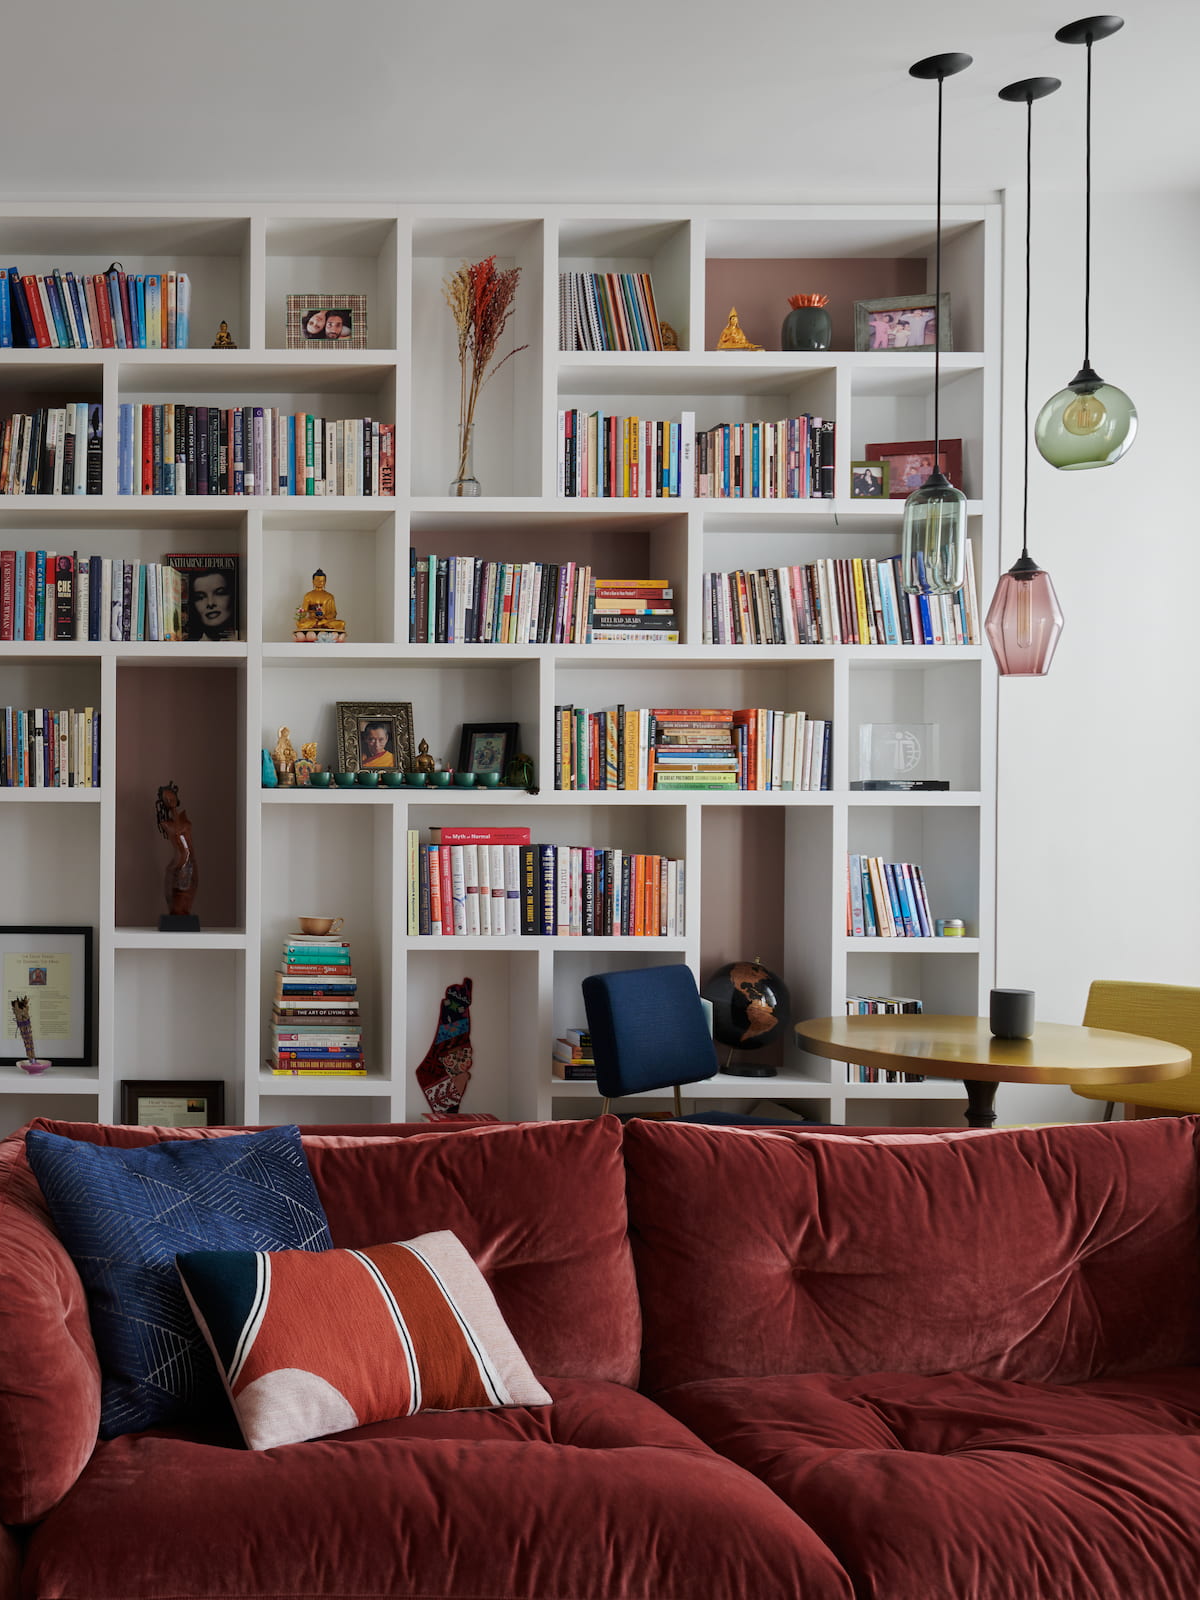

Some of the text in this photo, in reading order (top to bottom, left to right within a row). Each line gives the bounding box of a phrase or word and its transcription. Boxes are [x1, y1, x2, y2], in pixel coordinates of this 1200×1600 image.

[220, 446, 228, 474] Invasion
[382, 467, 392, 491] EXILE
[170, 558, 235, 569] KATHARINE HEPBURN
[57, 580, 71, 592] CHE
[545, 870, 553, 924] THE 4-HOUR BODY
[560, 869, 568, 905] nurture
